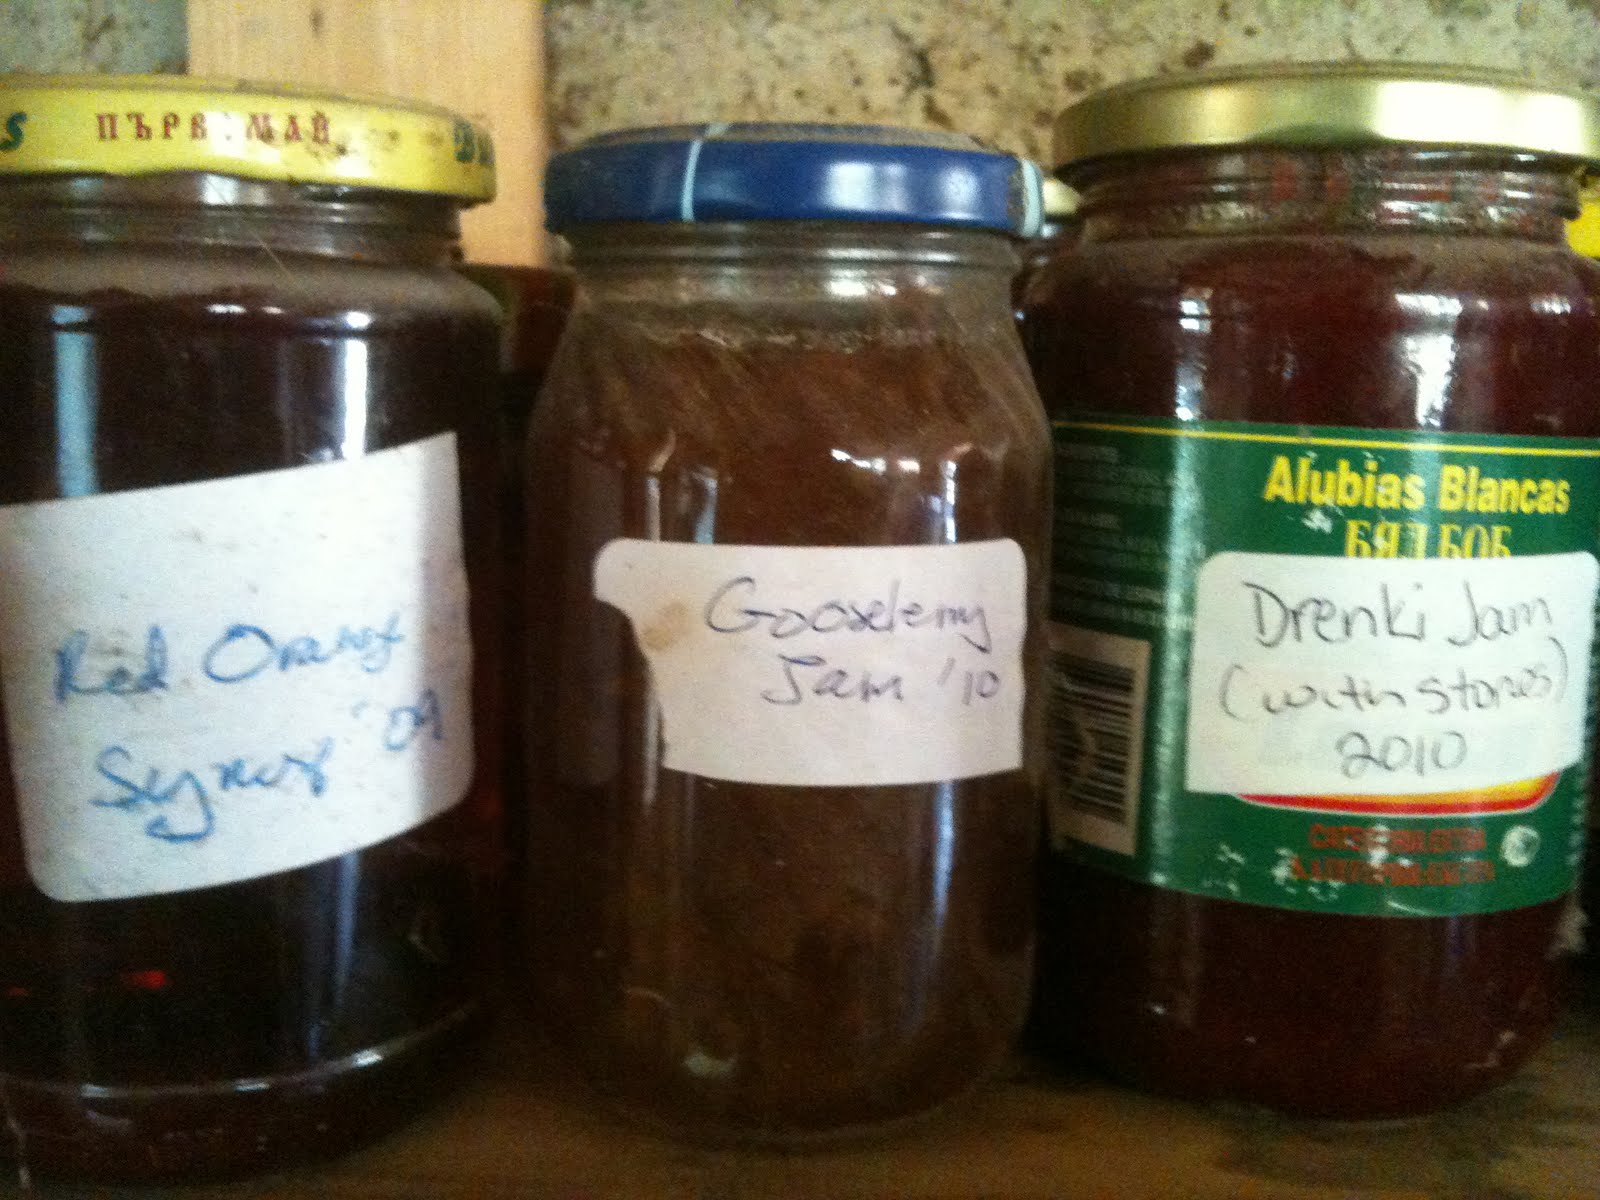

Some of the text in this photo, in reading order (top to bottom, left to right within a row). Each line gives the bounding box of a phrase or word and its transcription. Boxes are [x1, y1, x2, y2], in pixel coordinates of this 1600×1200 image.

[95, 111, 230, 141] ПЪРВ
[1263, 455, 1571, 514] Alubias Blancas
[1242, 581, 1425, 647] Drenki
[1447, 581, 1554, 646] Jam
[760, 654, 904, 705] Jam
[1335, 731, 1468, 778] 2010
